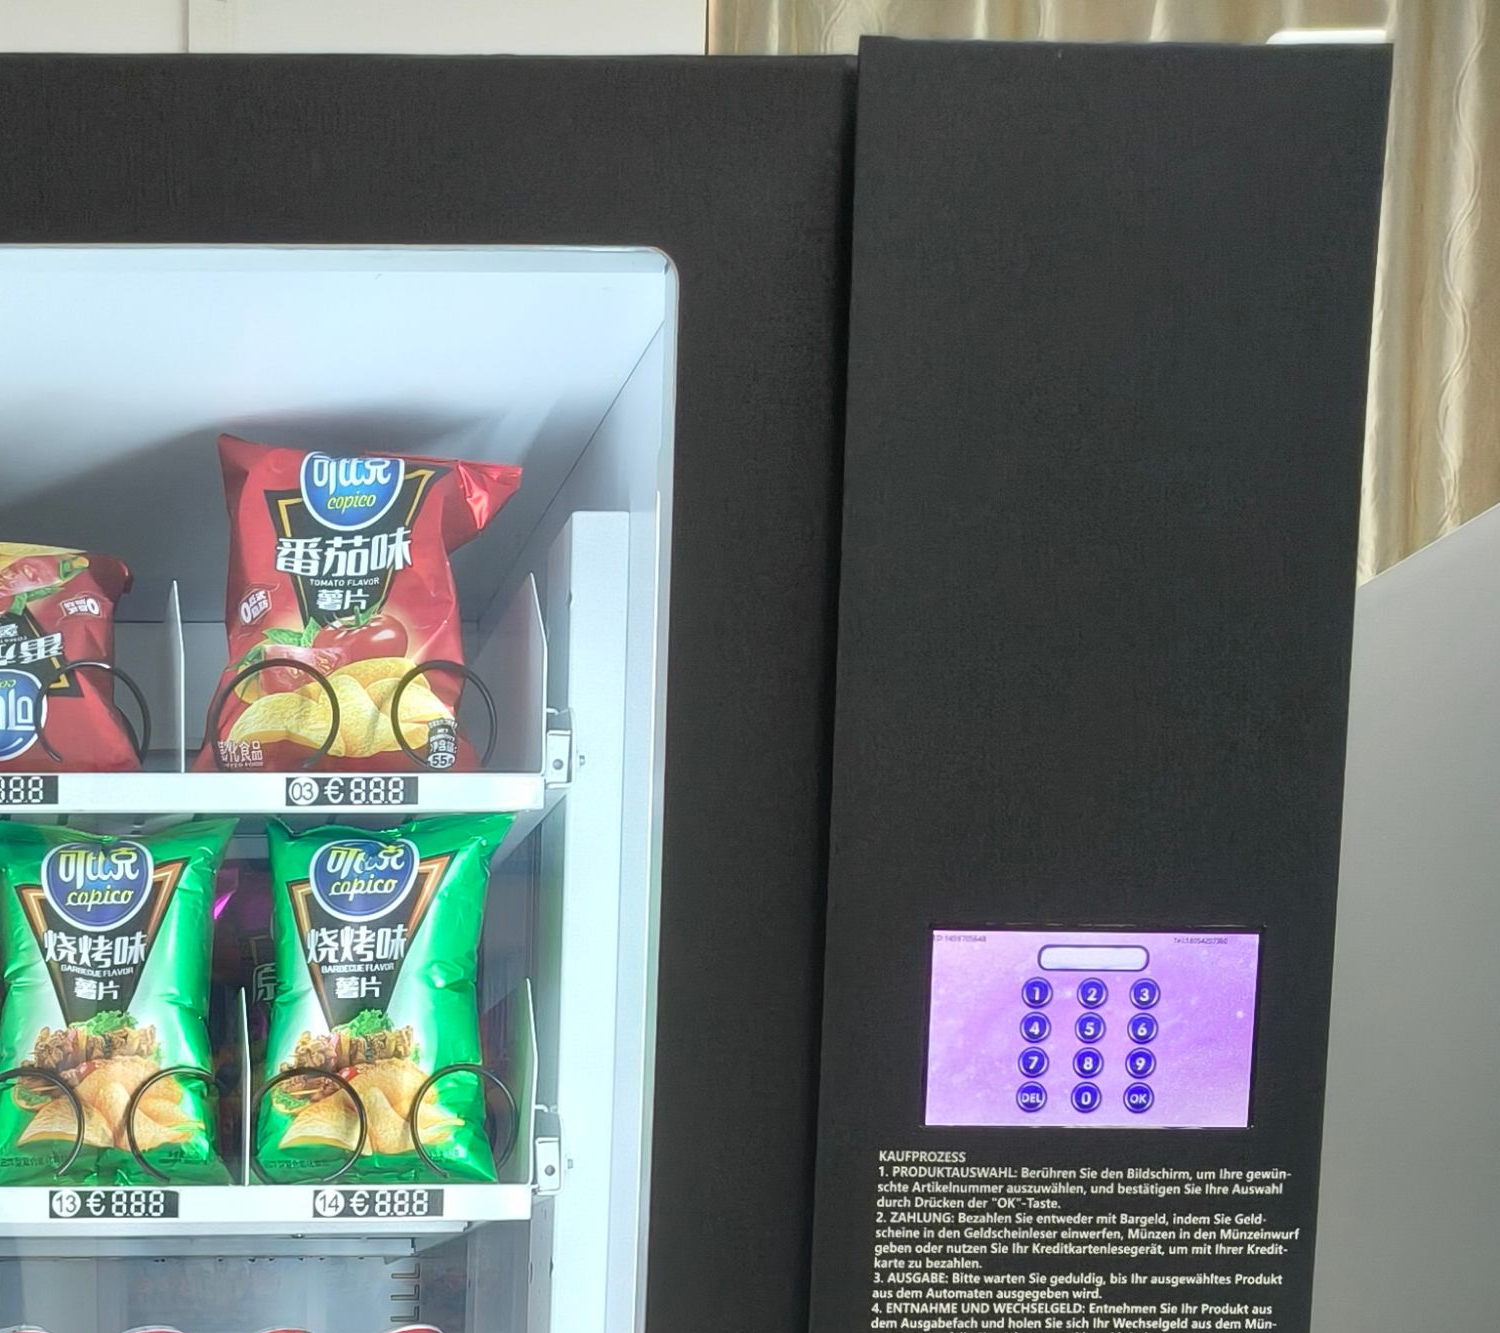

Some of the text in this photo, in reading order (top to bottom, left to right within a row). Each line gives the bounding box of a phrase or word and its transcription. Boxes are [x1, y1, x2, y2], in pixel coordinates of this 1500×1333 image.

[327, 491, 377, 514] copico
[276, 527, 413, 577] 番茄味
[310, 577, 380, 587] TOMATO FLAVOR
[317, 589, 369, 611] 薯片
[292, 784, 313, 800] 03
[329, 874, 398, 901] copico
[66, 885, 134, 912] copico
[44, 930, 147, 968] 烧烤味
[307, 924, 408, 963] 烧烤味
[74, 978, 120, 1000] 薯片
[335, 976, 382, 999] 薯片
[1032, 987, 1149, 1001] 1 2 3
[1029, 1022, 1147, 1036] 4 5 6
[1029, 1056, 1145, 1070] 7 8 9
[1021, 1093, 1042, 1104] DEL
[1129, 1093, 1147, 1105] OK
[879, 1151, 966, 1162] KAUFPROZESS
[879, 1166, 1291, 1182] 1. PRODUKTAUSWAHL: Berühren Sie den Bildschirm, um Ihre gewün-
[878, 1181, 1282, 1196] schte Artikelnummer auszuwählen, und bestätigen Sie Ihre Auswahl
[57, 1195, 75, 1211] 13
[319, 1195, 339, 1211] 14
[877, 1196, 1061, 1208] durch Drücken der "OK"-Taste.
[876, 1211, 1266, 1226] 2. ZAHLUNG: Bezahlen Sie entweder mit Bargeld, indem Sie Geld-
[876, 1226, 1300, 1240] scheine in den Geldscheinleser einwerfen, Münzen in den Münzeinwurf
[875, 1241, 1288, 1257] geben oder nutzen Sie Ihr Kreditkartenlesegerät, um mit Ihrer Kredit-
[874, 1256, 982, 1268] karte zu bezahlen.
[874, 1271, 1282, 1287] 3. AUSGABE: Bitte warten Sie geduldig, bis Ihr ausgewähltes Produkt
